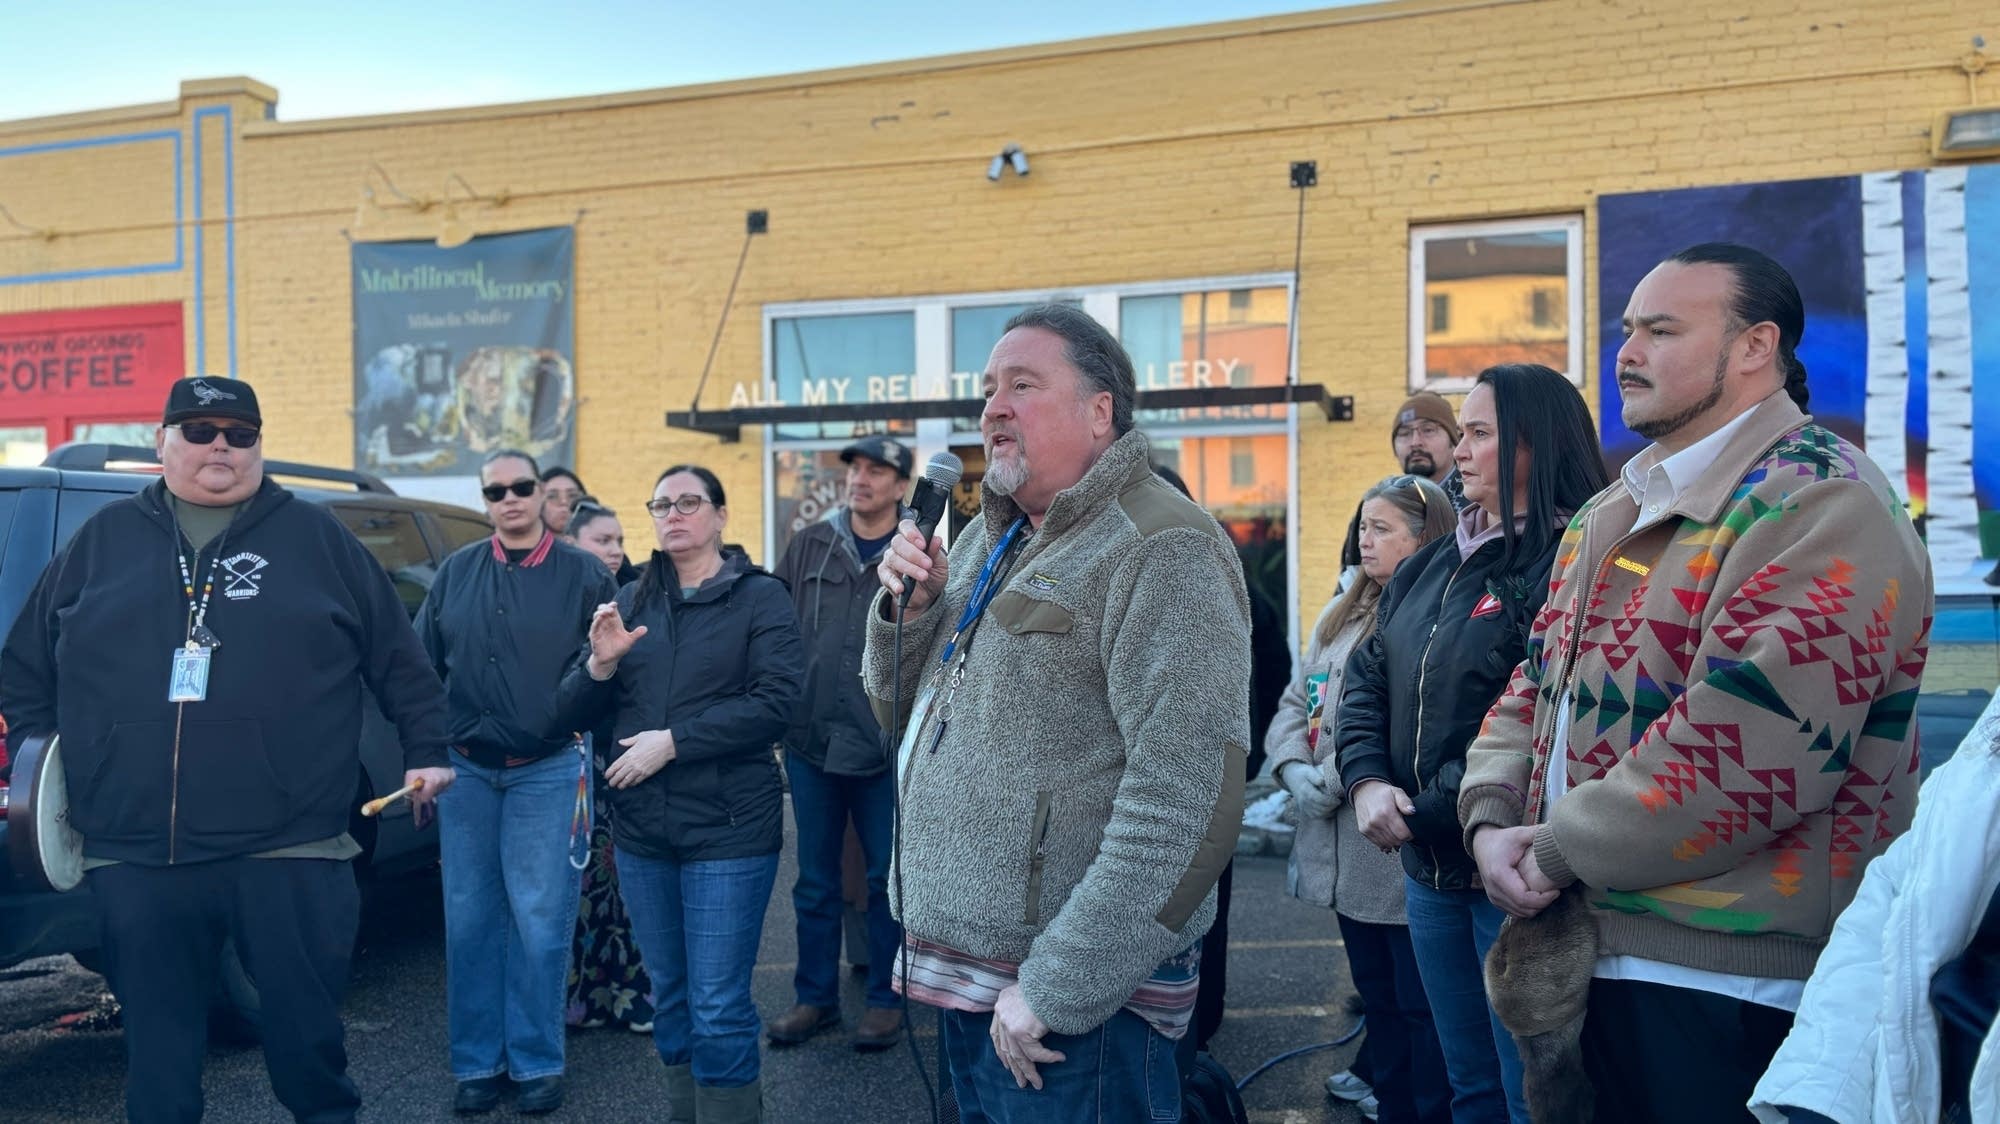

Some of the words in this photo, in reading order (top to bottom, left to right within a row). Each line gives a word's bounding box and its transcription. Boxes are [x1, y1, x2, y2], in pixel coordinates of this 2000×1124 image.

[361, 260, 483, 293] Matrilineal
[475, 278, 564, 302] Memory
[65, 333, 146, 351] GROUNDS
[730, 380, 786, 409] ALL
[802, 377, 851, 405] MY
[867, 371, 981, 402] RELATI
